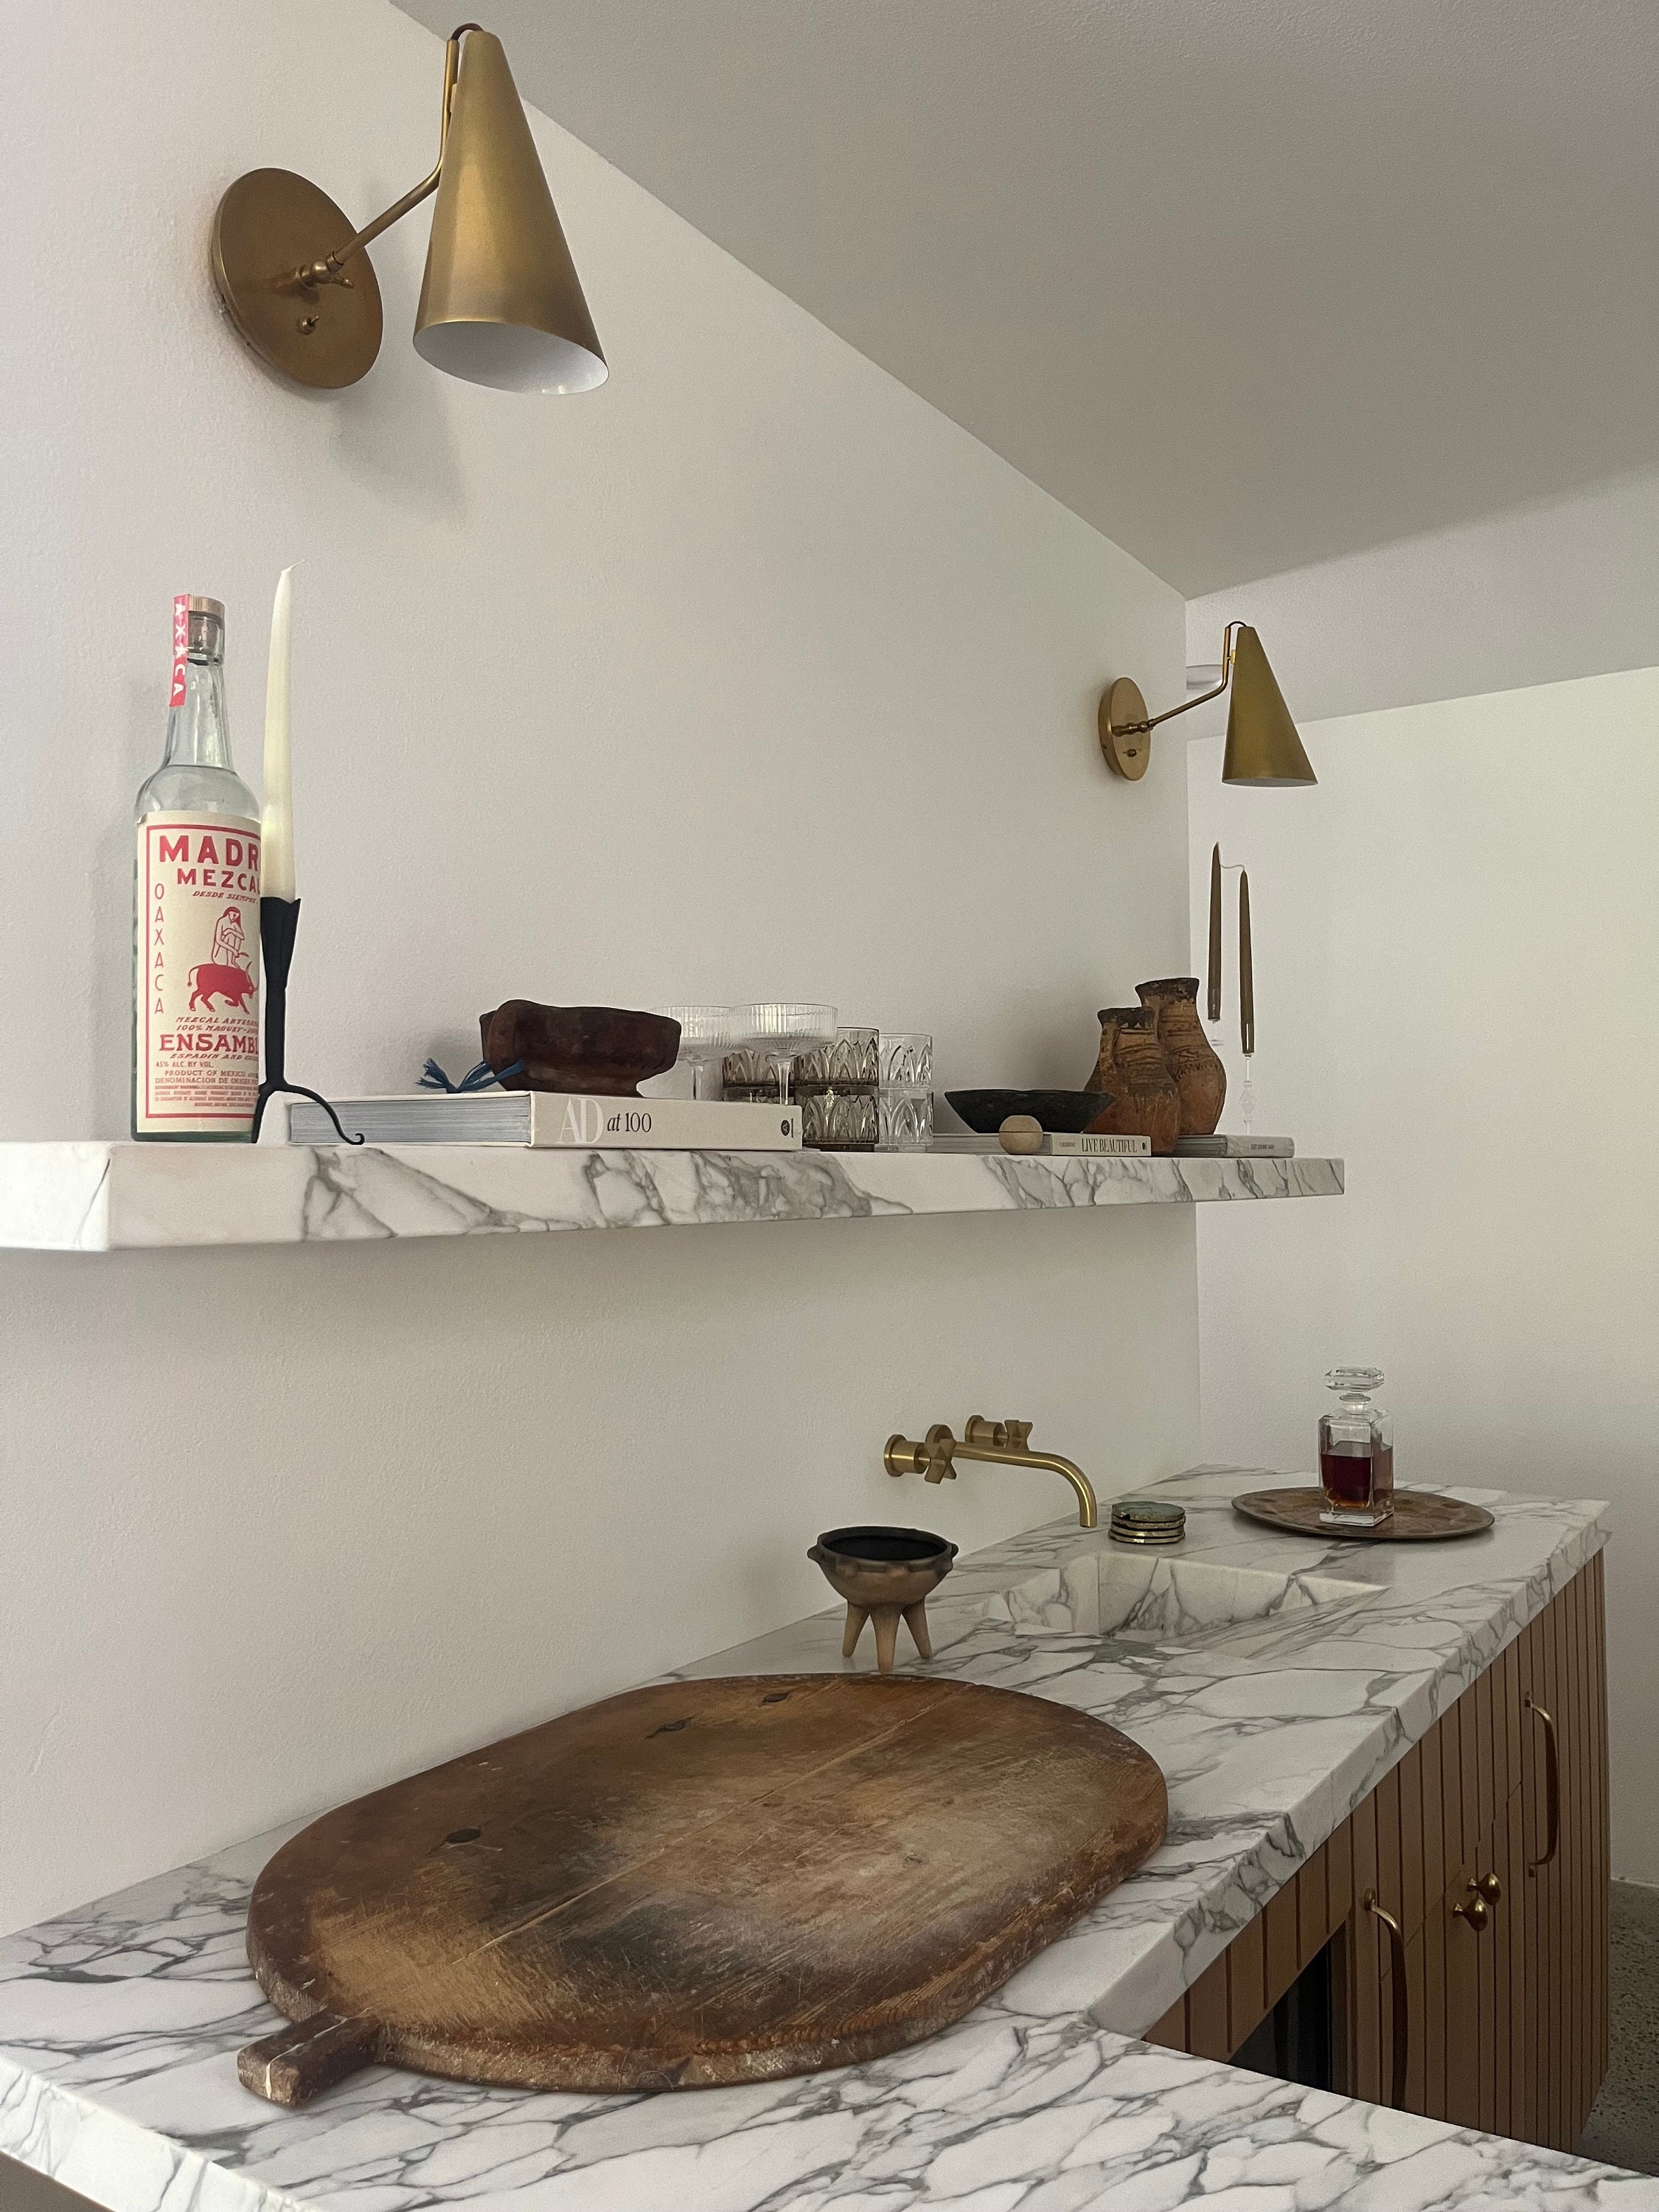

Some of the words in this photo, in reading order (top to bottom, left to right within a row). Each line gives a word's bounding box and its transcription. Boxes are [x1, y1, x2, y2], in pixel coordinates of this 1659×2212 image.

[557, 1097, 604, 1144] AD
[607, 1113, 622, 1132] at
[625, 1112, 652, 1133] 100
[1082, 1138, 1098, 1152] LIVE
[1099, 1138, 1137, 1152] BEAUTIFUL
